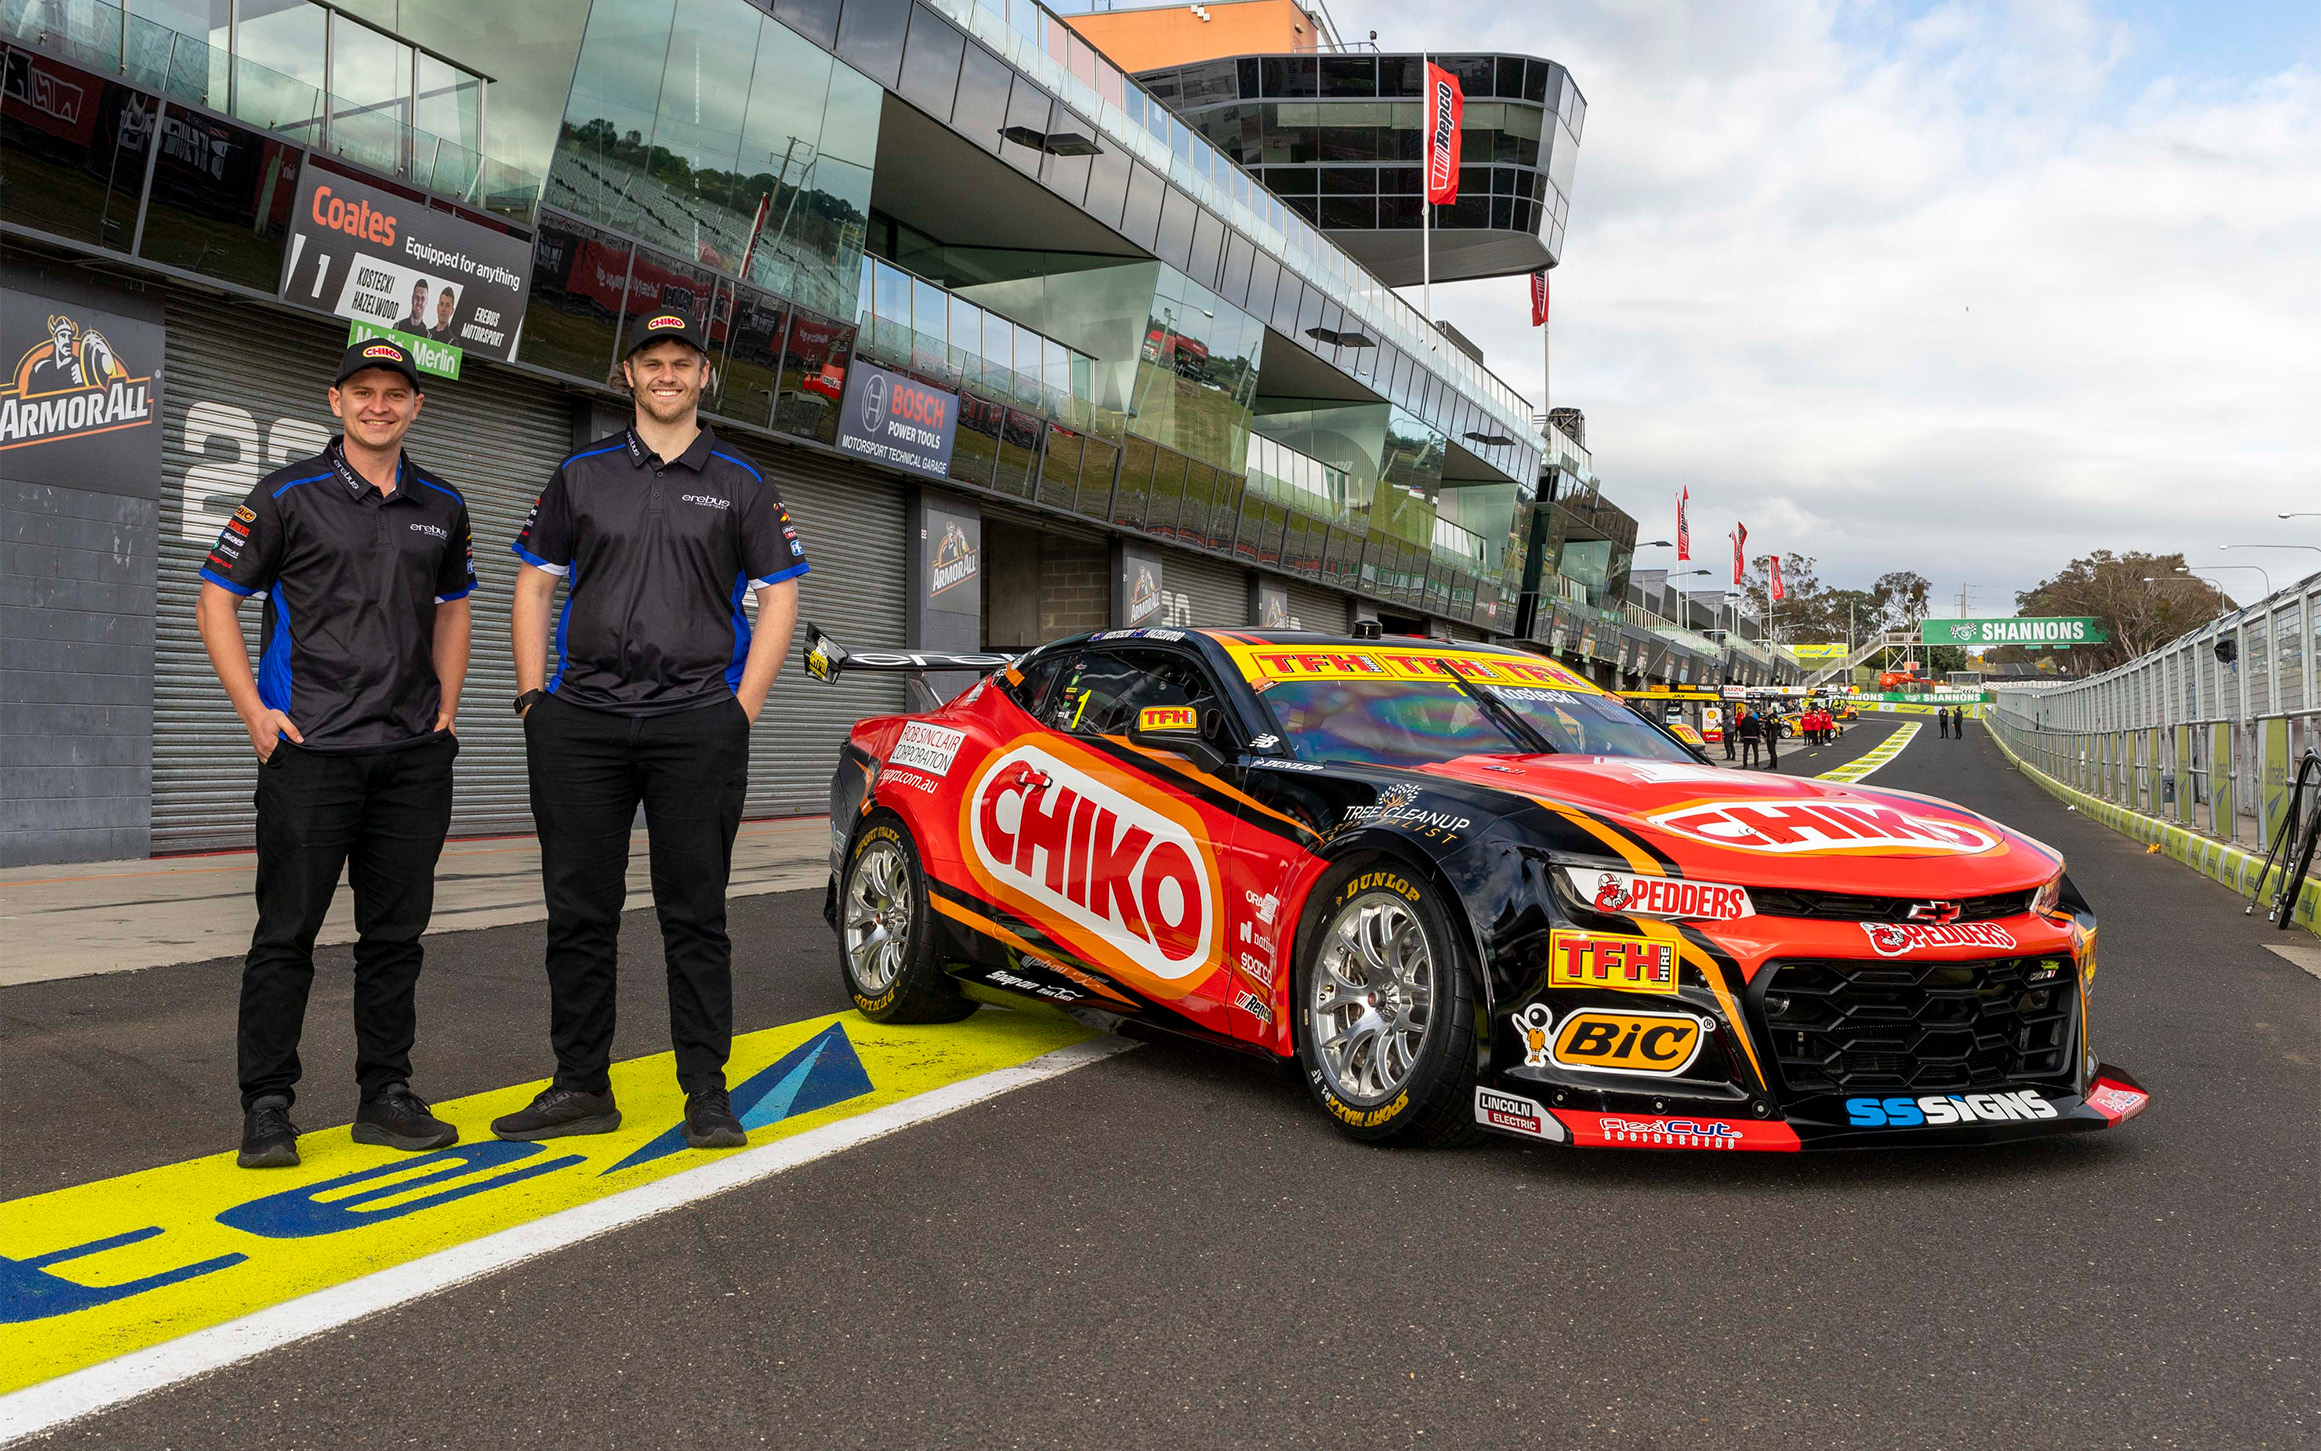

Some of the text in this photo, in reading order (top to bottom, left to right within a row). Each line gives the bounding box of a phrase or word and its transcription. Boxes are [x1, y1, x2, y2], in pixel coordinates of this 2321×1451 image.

[1435, 81, 1455, 151] Repco
[312, 185, 397, 247] Coates
[311, 254, 331, 298] 1
[405, 236, 521, 292] Equipped for anything
[356, 267, 396, 294] KOSTECKI
[351, 291, 399, 320] HAZELWOOD
[474, 307, 501, 327] EREBUS
[460, 323, 505, 348] MOTORSPORT
[650, 317, 684, 328] CHIKO
[364, 346, 401, 361] CHIKO
[412, 340, 456, 375] Merlin
[891, 384, 946, 430] BOSCH
[888, 421, 941, 450] POWER TOOLS
[841, 435, 947, 475] MOTORSPORT TECHNICAL GARAGE
[333, 459, 359, 489] erebus
[682, 494, 730, 508] erebus
[410, 523, 448, 538] erebus
[1981, 621, 2085, 640] SHANNONS
[1257, 653, 1370, 674] TFH
[1383, 655, 1486, 677] TFH
[1490, 661, 1572, 686] TFH
[1071, 689, 1092, 729] 1
[1485, 684, 1582, 706] Kostecki
[1923, 692, 1981, 702] SHANNONS
[1144, 710, 1188, 726] TFH
[901, 725, 961, 753] ROB SINCLAIR
[892, 743, 953, 772] CORPORATION
[1263, 759, 1324, 772] DUNLOP
[1342, 805, 1471, 832] TREE CLEANUP
[1663, 805, 1985, 849] CHIKO
[980, 760, 1202, 961] CHIKO
[1346, 871, 1421, 902] DUNLOP
[1631, 879, 1745, 920] PEDDERS
[1906, 921, 2016, 950] PEDDERS
[1240, 951, 1273, 984] sparco
[1557, 938, 1671, 982] TFH HIRE
[1364, 1088, 1409, 1127] SPORT
[1481, 1095, 1532, 1118] LINCOLN
[1493, 1113, 1538, 1131] ELECTRIC
[1604, 1130, 1735, 1149] ENGINEERING
